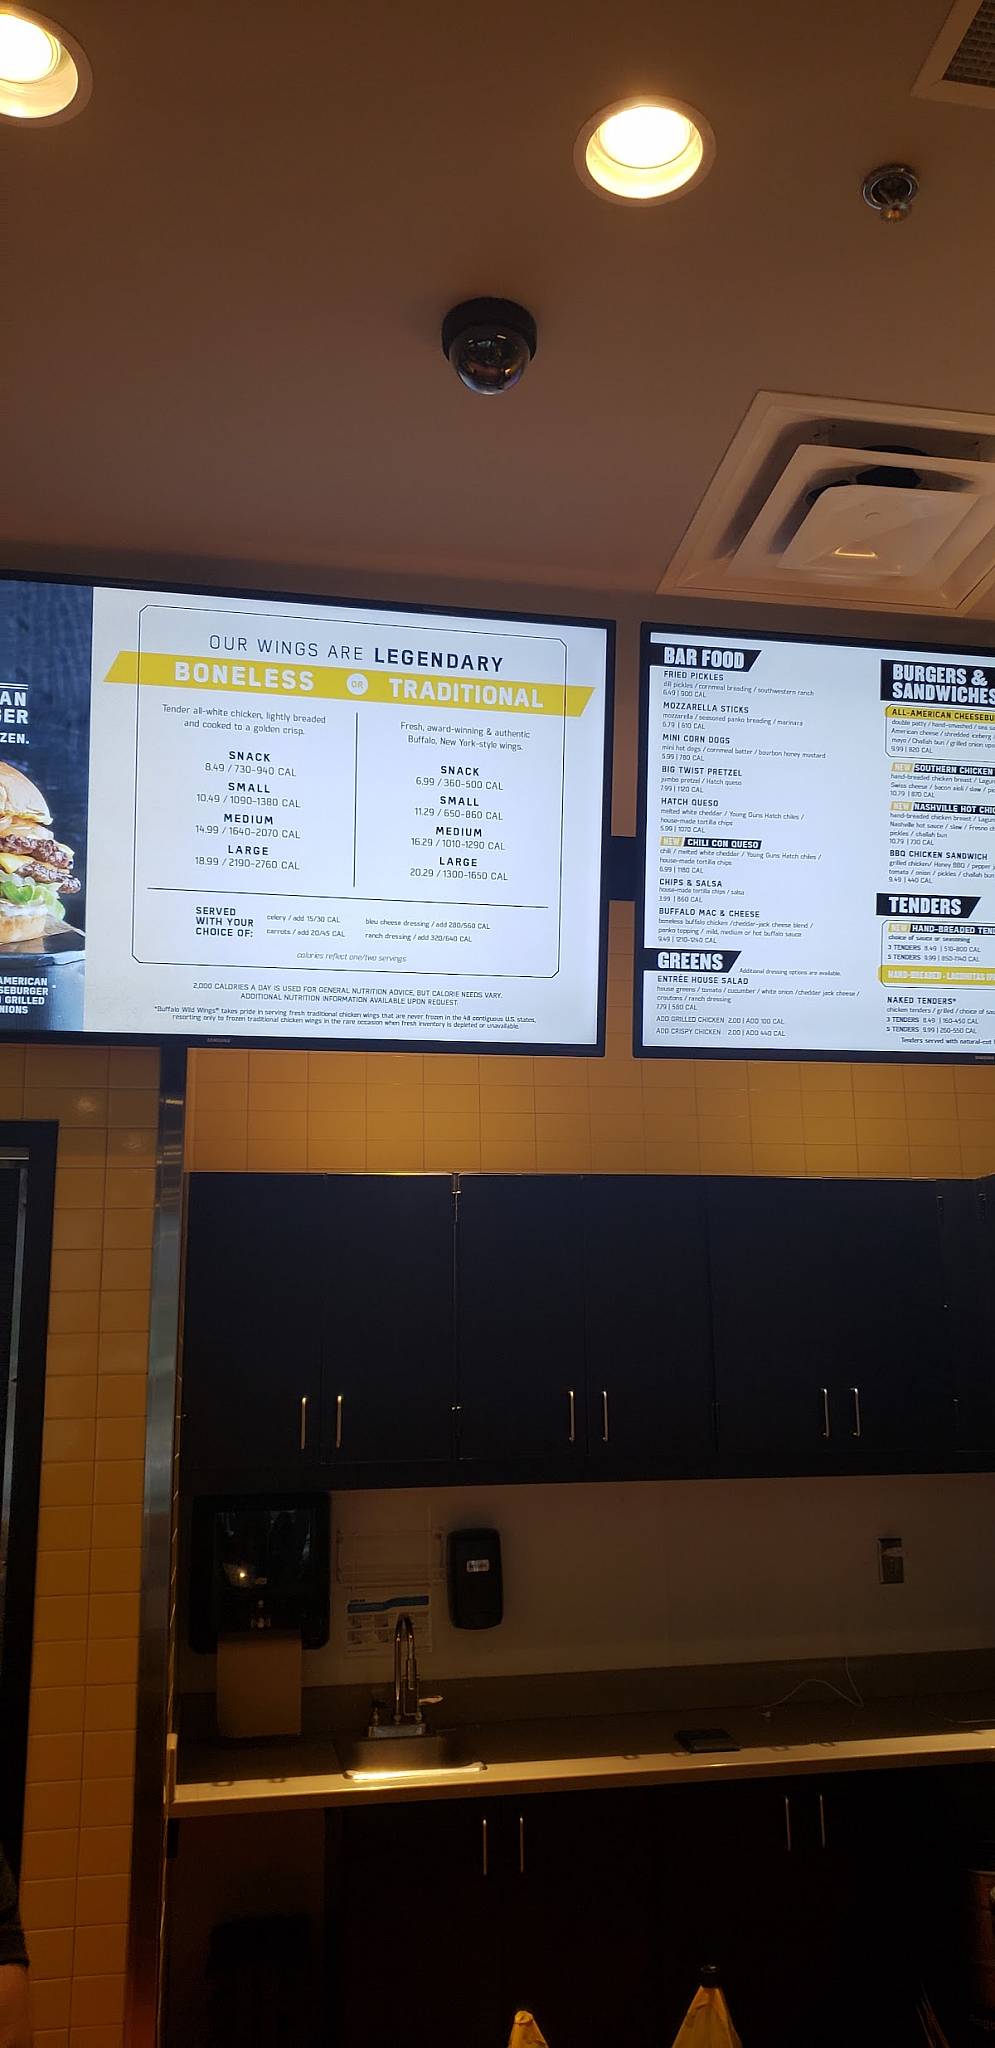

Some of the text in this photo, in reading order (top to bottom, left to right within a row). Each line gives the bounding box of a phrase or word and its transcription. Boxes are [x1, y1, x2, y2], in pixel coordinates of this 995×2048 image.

[209, 634, 503, 672] OUR WINGS ARE LEGENDARY
[663, 646, 744, 669] BAR FOOD
[663, 670, 723, 681] FRIED PICKLES
[892, 663, 988, 686] BURGERS &
[175, 661, 543, 708] BONELESS OR TRADITIONAL
[663, 701, 748, 713] MOZZARELLA STICKS
[891, 707, 951, 719] ALL-AMERICAN
[162, 703, 326, 726] Tender all-white chicken, lightly breaded
[183, 718, 200, 727] and
[201, 719, 232, 731] cooked
[234, 723, 244, 733] to
[245, 724, 250, 733] a
[253, 723, 280, 734] golden
[400, 721, 531, 738] Fresh, award-winning & authentic
[408, 734, 524, 752] Buffalo, New York-style wings.
[662, 733, 730, 744] MINI CORN DOGS
[229, 750, 270, 762] SNACK
[204, 762, 296, 776] 8.49 730-940 CAL
[440, 765, 479, 776] SNACK
[661, 765, 742, 776] BIG TWIST PRETZEL
[914, 763, 957, 773] SOUTHERN
[959, 766, 993, 775] CHICKEN
[228, 782, 270, 793] SMALL
[415, 776, 503, 790] 6.99 360-500 CAL
[196, 793, 301, 808] 10.49 1090-1380 CAL
[440, 795, 479, 806] SMALL
[661, 797, 718, 807] HATCH QUESO
[914, 802, 958, 812] NASHVILLE
[224, 813, 273, 825] MEDIUM
[415, 807, 503, 820] 11.29 650-860 CAL
[195, 824, 300, 839] 14.99 1640-2070 CAL
[435, 826, 481, 837] MEDIUM
[411, 837, 505, 850] 16.29 1010-1290 CAL
[687, 838, 709, 846] CHILI
[709, 839, 730, 848] CON
[730, 840, 760, 850] QUESO
[228, 845, 268, 855] LARGE
[889, 849, 987, 860] BBQ CHICKEN SANDWICH
[195, 856, 300, 870] 18.99 2190-2760 CAL
[439, 856, 477, 866] LARGE
[410, 867, 508, 881] 20.29 1300-1650 CAL
[659, 878, 683, 886] CHIPS
[695, 879, 722, 887] SALSA
[195, 906, 235, 916] SERVED
[888, 896, 961, 915] TENDERS
[659, 907, 695, 915] BUFFALO
[698, 908, 716, 916] MAC
[728, 910, 759, 918] CHEESE
[195, 916, 253, 927] WITH YOUR
[403, 919, 429, 928] dressing
[195, 927, 253, 937] CHOICE OF:
[912, 924, 977, 935] HAND-BREADED
[384, 933, 411, 942] dressing
[657, 951, 723, 970] GREENS
[193, 982, 212, 990] 2,000
[214, 982, 249, 990] CALORIES
[250, 984, 256, 992] A
[318, 986, 350, 994] GENERAL
[351, 987, 387, 995] NUTRITION
[4, 996, 45, 1005] GRILLED
